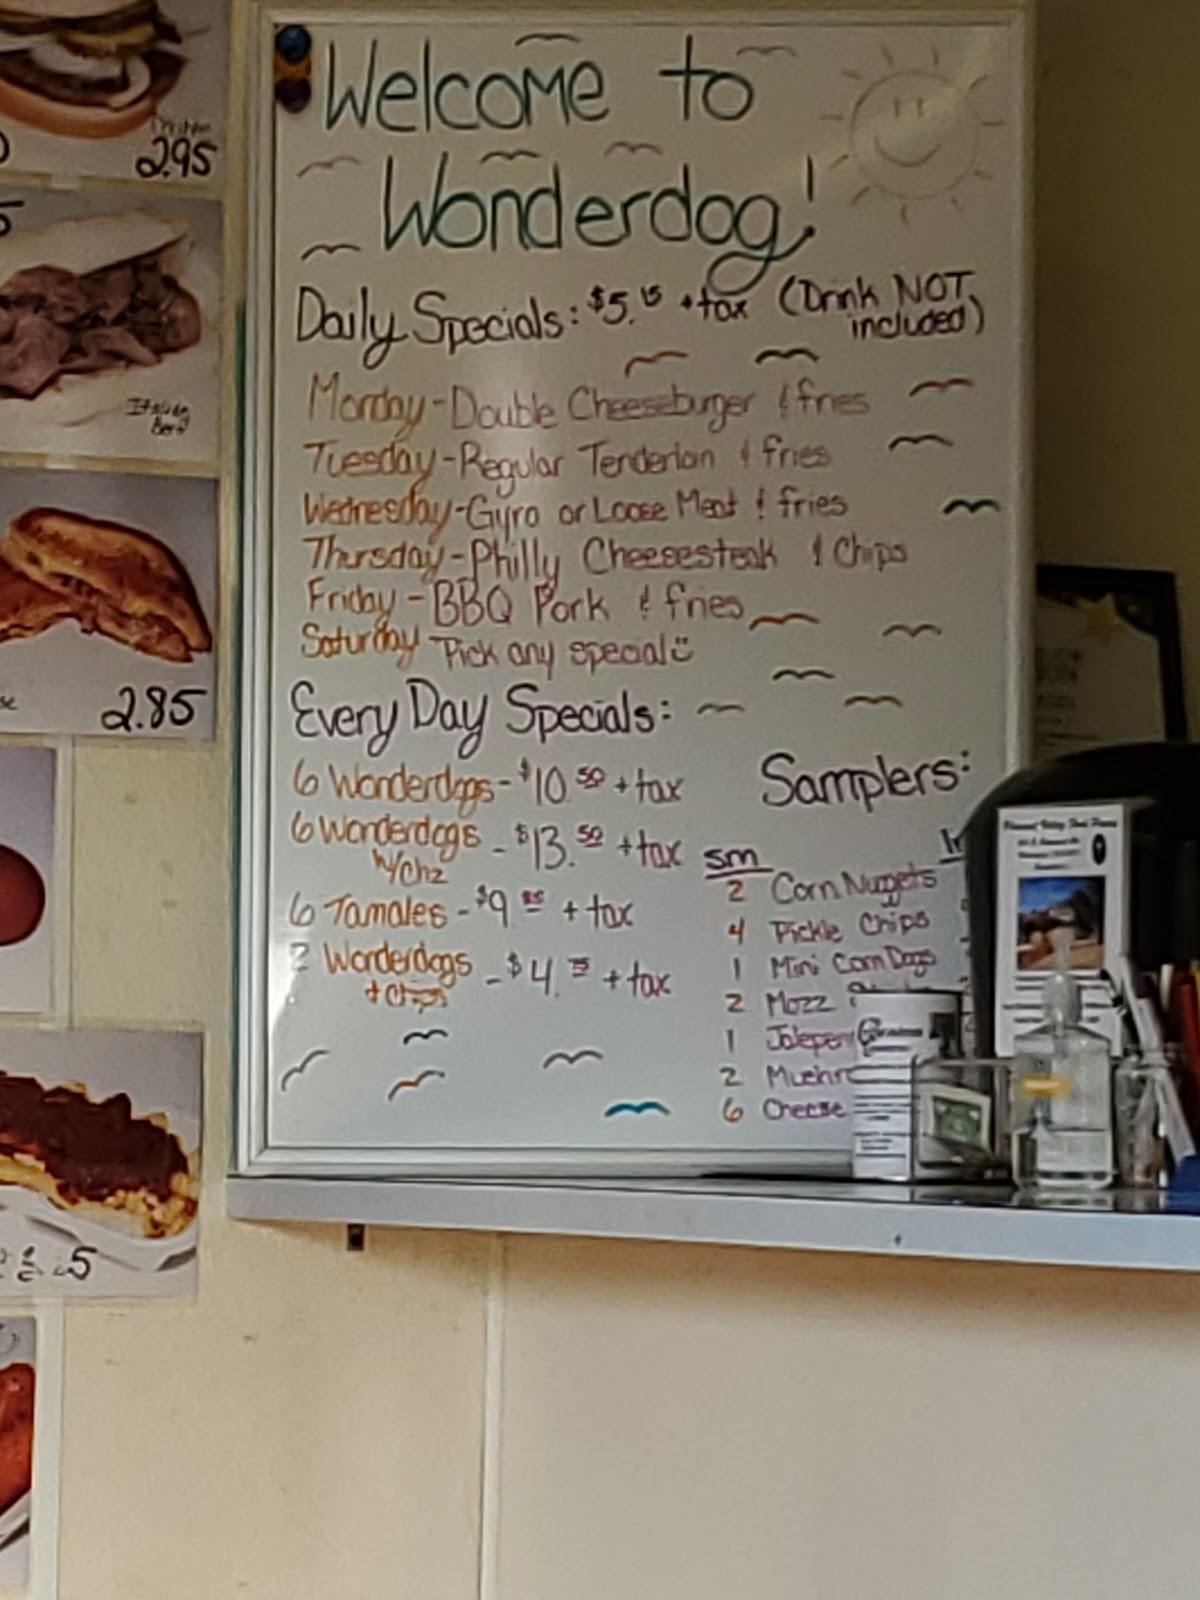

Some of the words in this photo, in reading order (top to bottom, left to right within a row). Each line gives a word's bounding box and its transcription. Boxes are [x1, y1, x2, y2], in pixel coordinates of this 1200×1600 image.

[324, 39, 609, 133] Welcome
[660, 34, 755, 122] to
[135, 136, 218, 178] 2.95
[384, 152, 816, 296] Wonderdog!
[297, 286, 409, 370] Daily
[412, 290, 578, 355] Specials:
[893, 270, 974, 303] NOT
[307, 372, 426, 440] Monday
[451, 386, 557, 429] Double
[566, 385, 755, 433] Cheeseburger
[796, 377, 869, 418] fries
[303, 439, 437, 495] Tuesday
[460, 441, 565, 499] Regular
[762, 434, 832, 470] fries
[303, 490, 452, 545] Wednesday
[466, 494, 540, 545] Gyro
[558, 503, 586, 526] or
[592, 497, 669, 525] Loose
[676, 489, 737, 521] Meat
[778, 485, 848, 518] fries
[302, 534, 445, 584] Thursday
[470, 537, 561, 590] Philly
[583, 535, 778, 576] Cheesesteak
[833, 532, 908, 572] Chips
[307, 576, 396, 626] Friday
[433, 577, 514, 627] BBQ
[535, 582, 611, 627] Pork
[665, 580, 744, 620] fries
[301, 622, 420, 669] Saturday
[508, 641, 556, 681] any
[568, 635, 668, 675] special
[100, 685, 208, 733] 2.85
[290, 680, 399, 757] Every
[405, 677, 488, 760] Day
[505, 682, 672, 744] Specials:
[293, 757, 320, 797] 6
[328, 762, 496, 819] Wonderdogs
[635, 766, 685, 804] tax
[760, 750, 972, 814] Samplers:
[291, 810, 315, 845] 6
[319, 812, 482, 863] Wonderdogs
[635, 828, 683, 869] tax
[289, 890, 315, 927] 6
[323, 891, 449, 929] Tamales
[584, 894, 634, 930] tax
[725, 878, 747, 902] 2
[771, 871, 842, 906] Corn
[841, 862, 938, 908] Nuggets
[728, 918, 746, 945] 4
[860, 910, 931, 936] Chips
[323, 939, 474, 988] Wonderdogs
[626, 960, 672, 998] tax
[884, 944, 938, 979] Dogs
[725, 993, 746, 1013] 2
[719, 1066, 744, 1087] 2
[722, 1097, 745, 1124] 6
